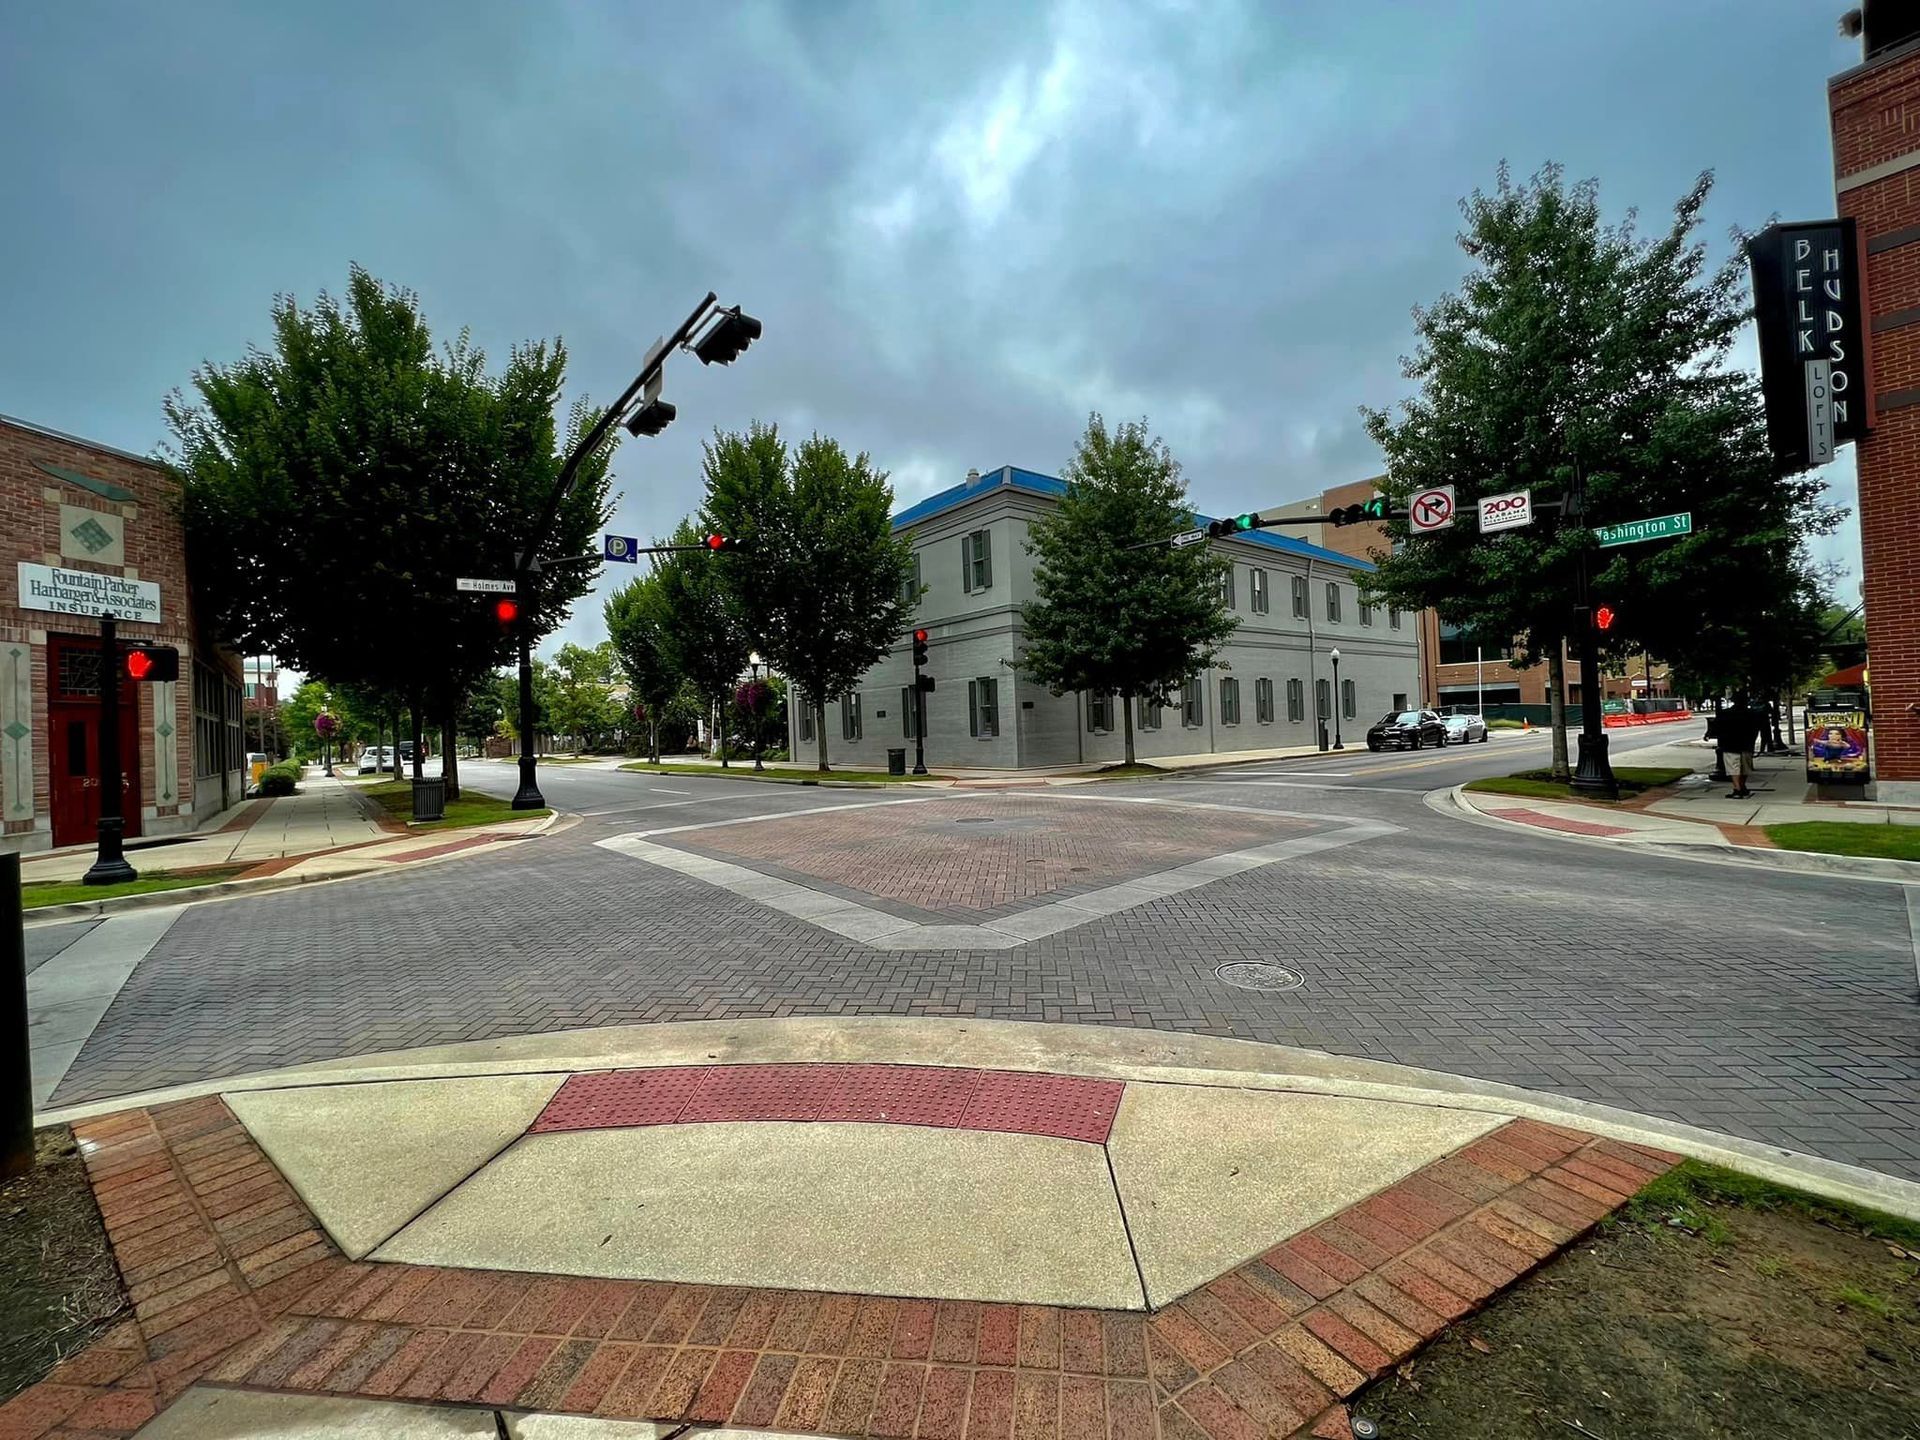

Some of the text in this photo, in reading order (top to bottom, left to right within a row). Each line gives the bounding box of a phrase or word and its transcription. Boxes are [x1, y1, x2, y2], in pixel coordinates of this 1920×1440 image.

[1795, 239, 1814, 352] BELK
[1823, 249, 1848, 422] HUDSON
[1813, 367, 1828, 456] LOFTS
[1483, 496, 1527, 515] 200
[1673, 515, 1687, 529] St
[613, 540, 625, 554] P
[104, 576, 140, 595] Parker
[473, 580, 499, 590] Holmes
[502, 582, 514, 591] Ave
[50, 601, 142, 620] INSURANCE
[101, 591, 156, 611] Associates
